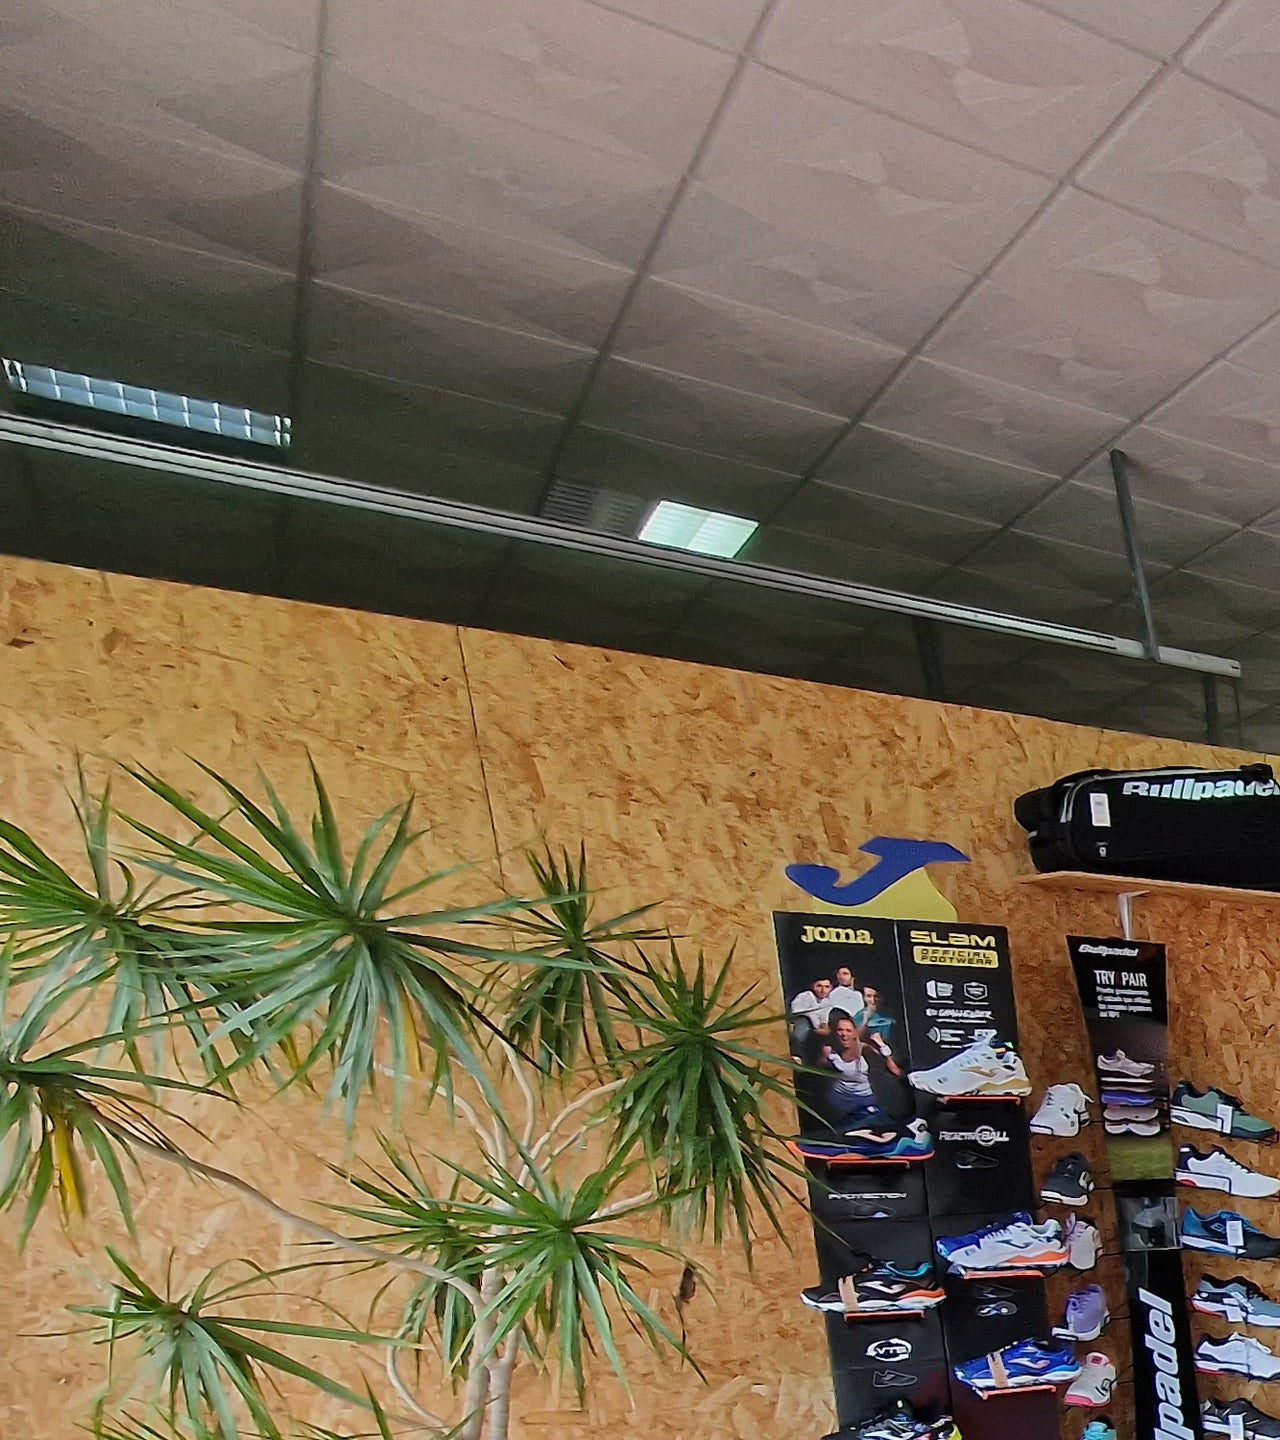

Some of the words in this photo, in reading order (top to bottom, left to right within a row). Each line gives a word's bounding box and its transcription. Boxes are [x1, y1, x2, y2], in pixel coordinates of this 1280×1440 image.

[920, 948, 990, 958] OFFICIAL
[920, 956, 993, 966] FOOTWEAR
[1093, 970, 1115, 985] TRY
[1121, 972, 1148, 988] PAIR
